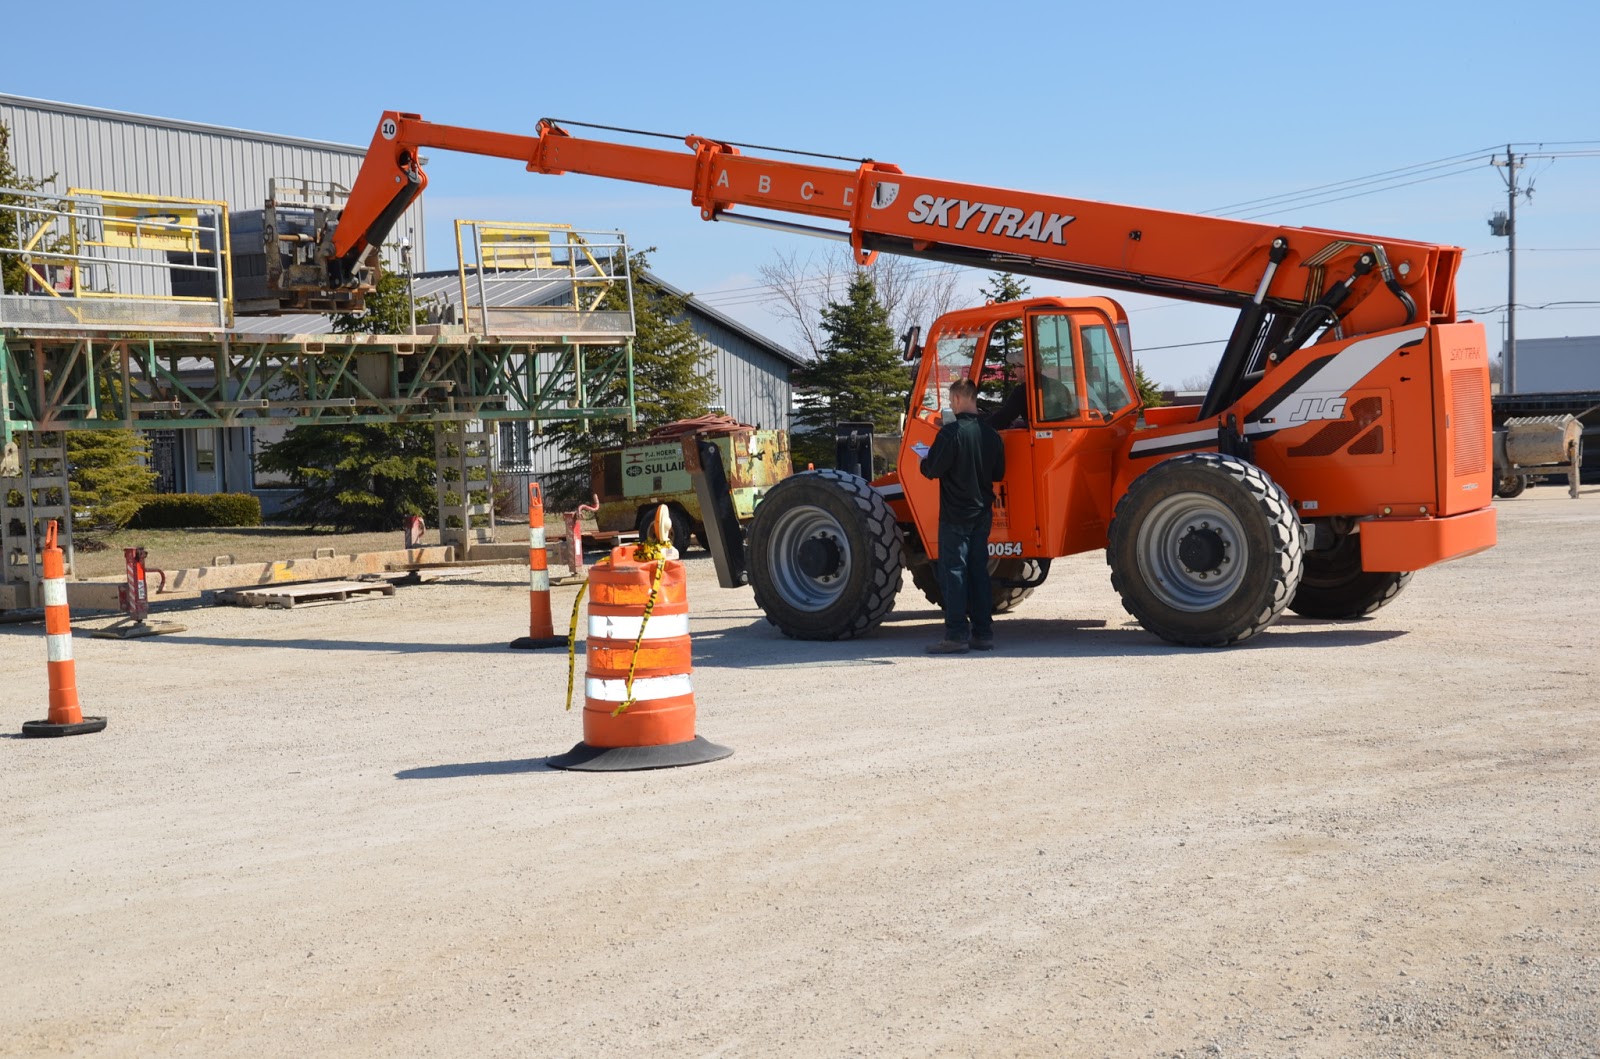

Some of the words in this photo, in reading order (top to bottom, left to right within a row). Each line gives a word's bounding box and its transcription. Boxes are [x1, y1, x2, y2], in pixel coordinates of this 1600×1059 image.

[382, 123, 395, 135] 10
[716, 169, 729, 188] A
[758, 174, 771, 193] B
[800, 181, 814, 200] C
[907, 194, 1076, 245] SKYTRAK
[1289, 397, 1348, 422] JLG
